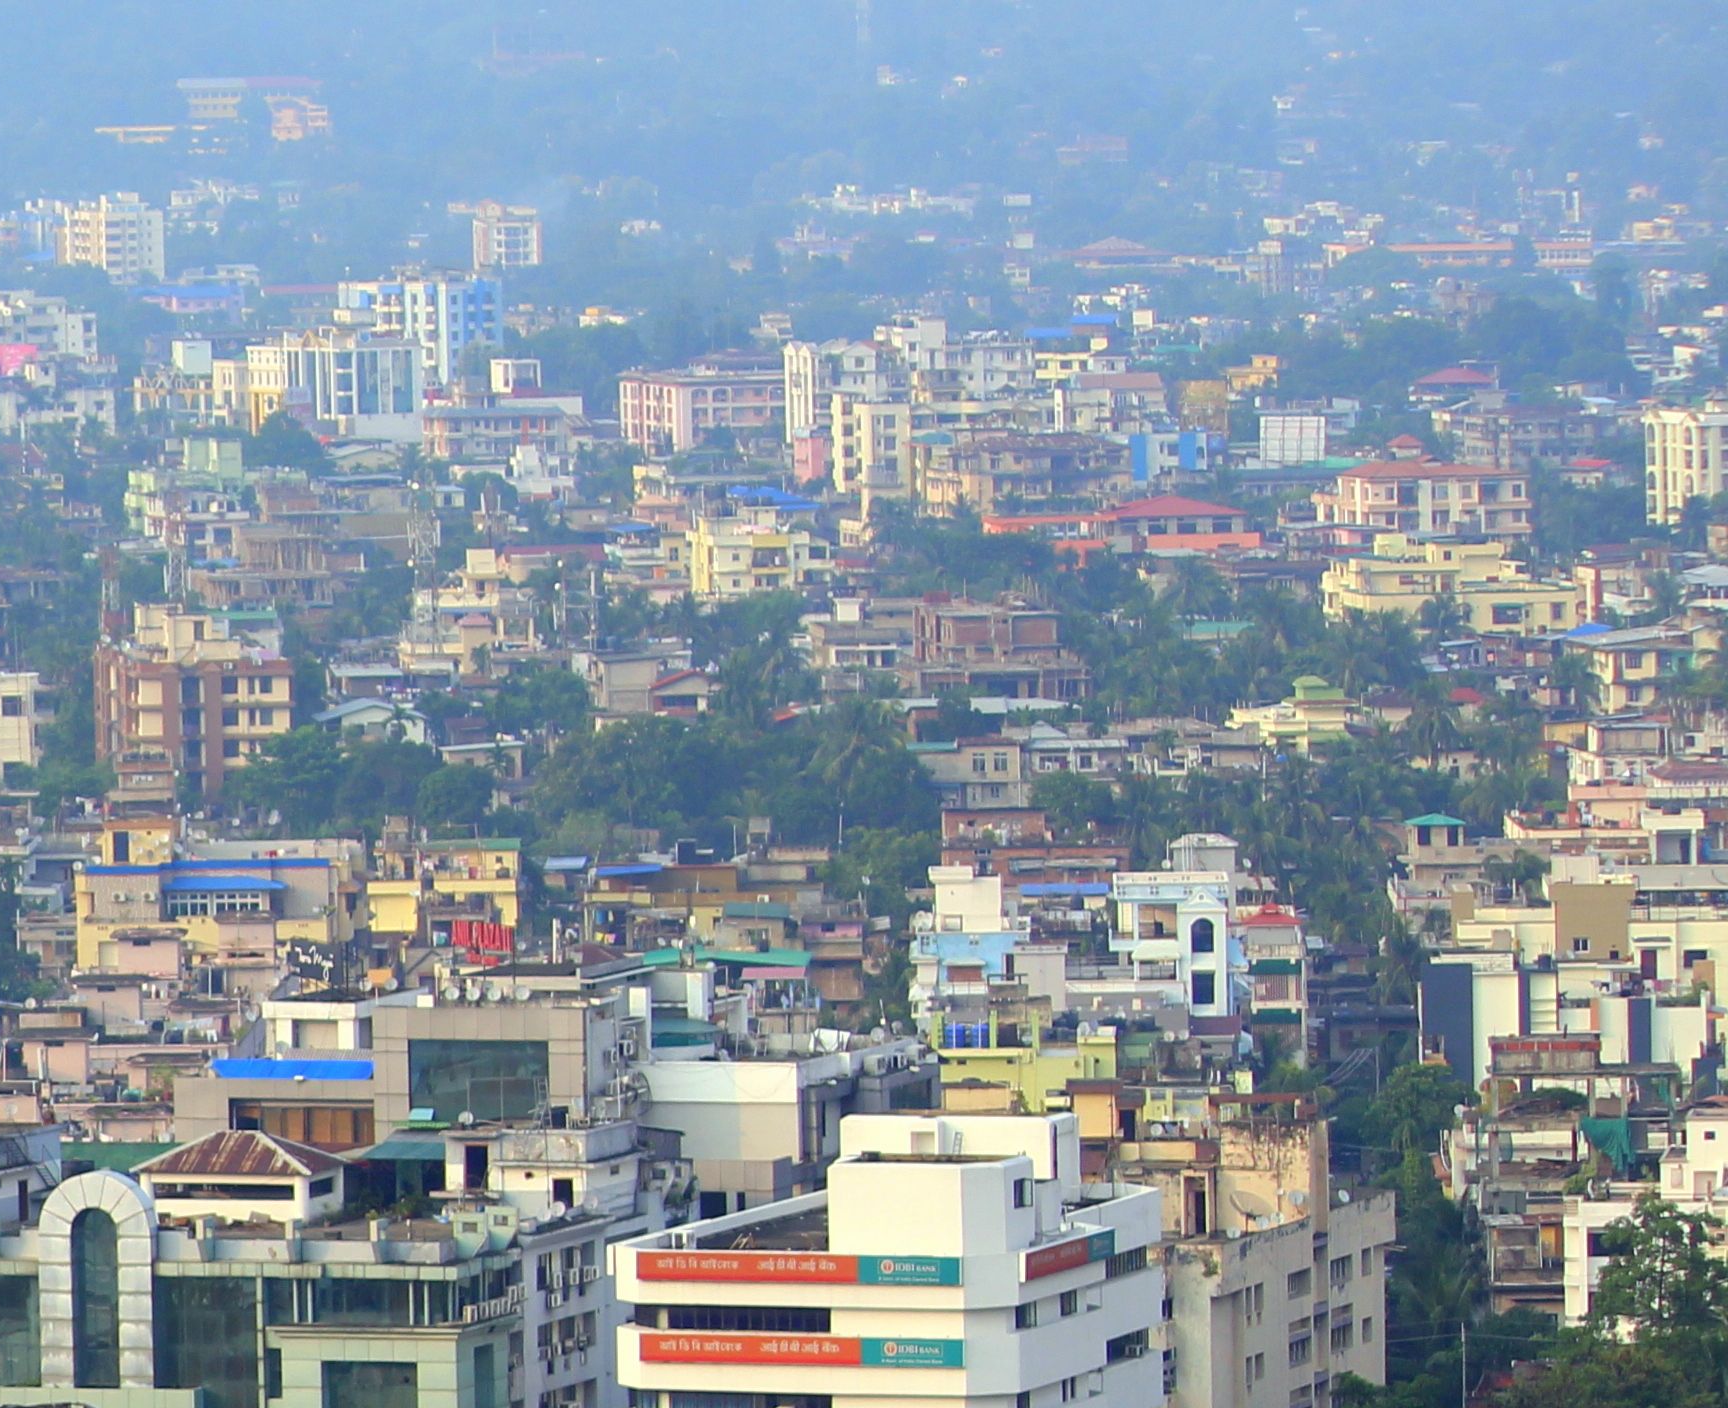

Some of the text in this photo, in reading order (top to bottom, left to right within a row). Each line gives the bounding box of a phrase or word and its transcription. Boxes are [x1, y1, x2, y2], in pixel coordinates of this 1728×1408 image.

[452, 920, 471, 946] ANIL
[472, 922, 501, 950] PLAZA
[895, 1262, 914, 1272] IDBI
[898, 1345, 918, 1354] IDBI
